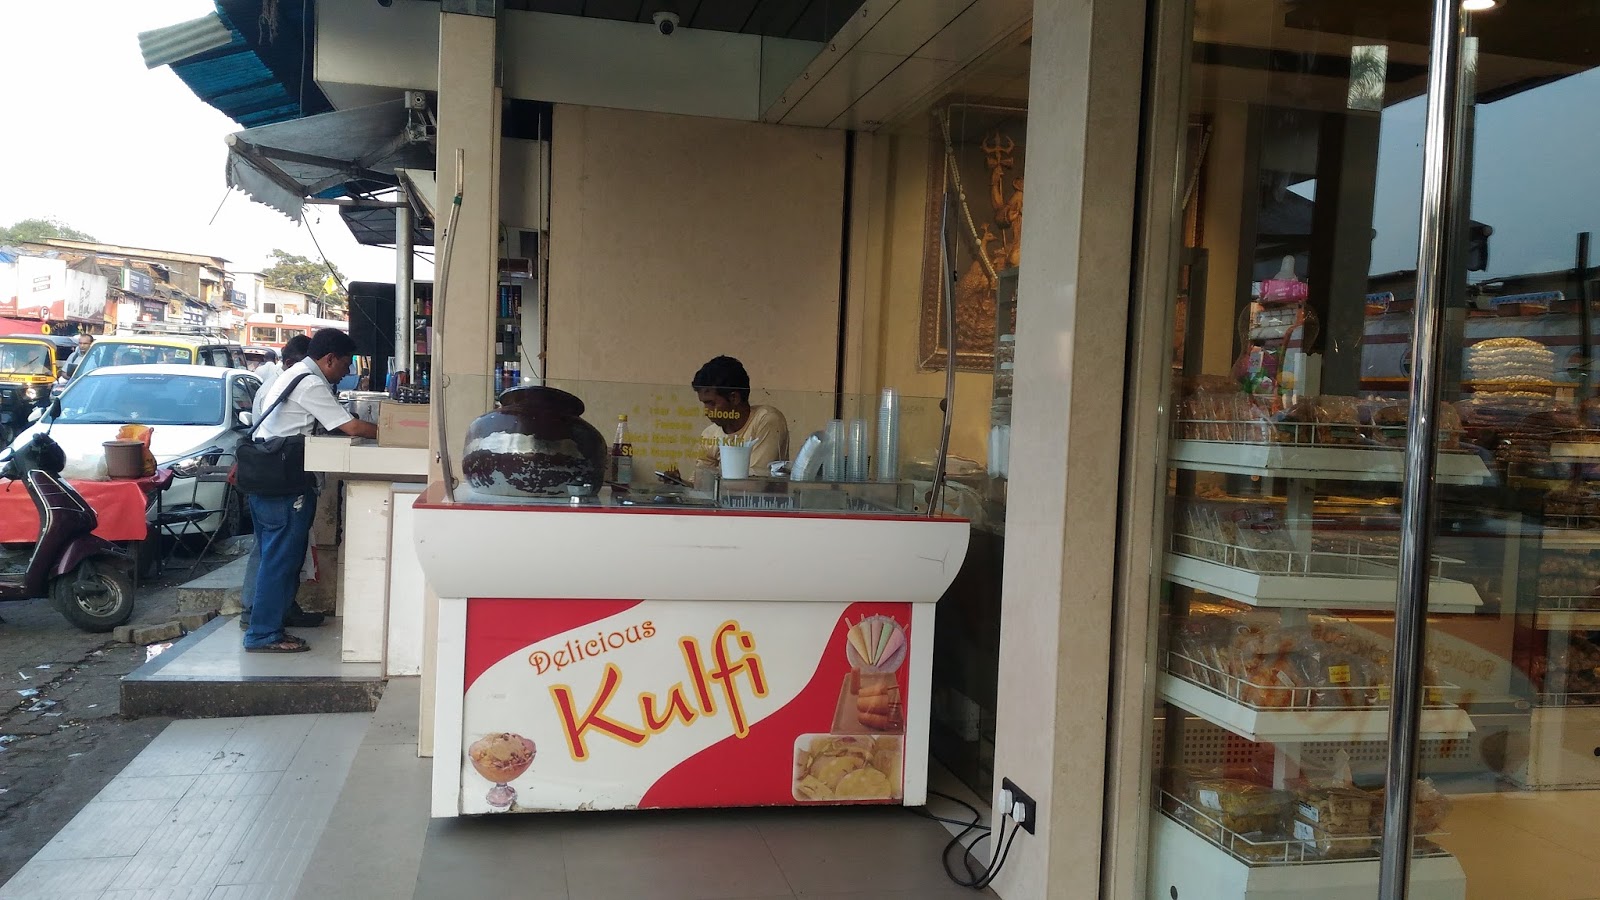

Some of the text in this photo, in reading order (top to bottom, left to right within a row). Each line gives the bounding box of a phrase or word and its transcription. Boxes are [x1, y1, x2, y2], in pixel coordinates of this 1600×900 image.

[704, 407, 741, 420] Falooda
[528, 620, 657, 676] Delicious
[548, 619, 770, 763] Kulfi
